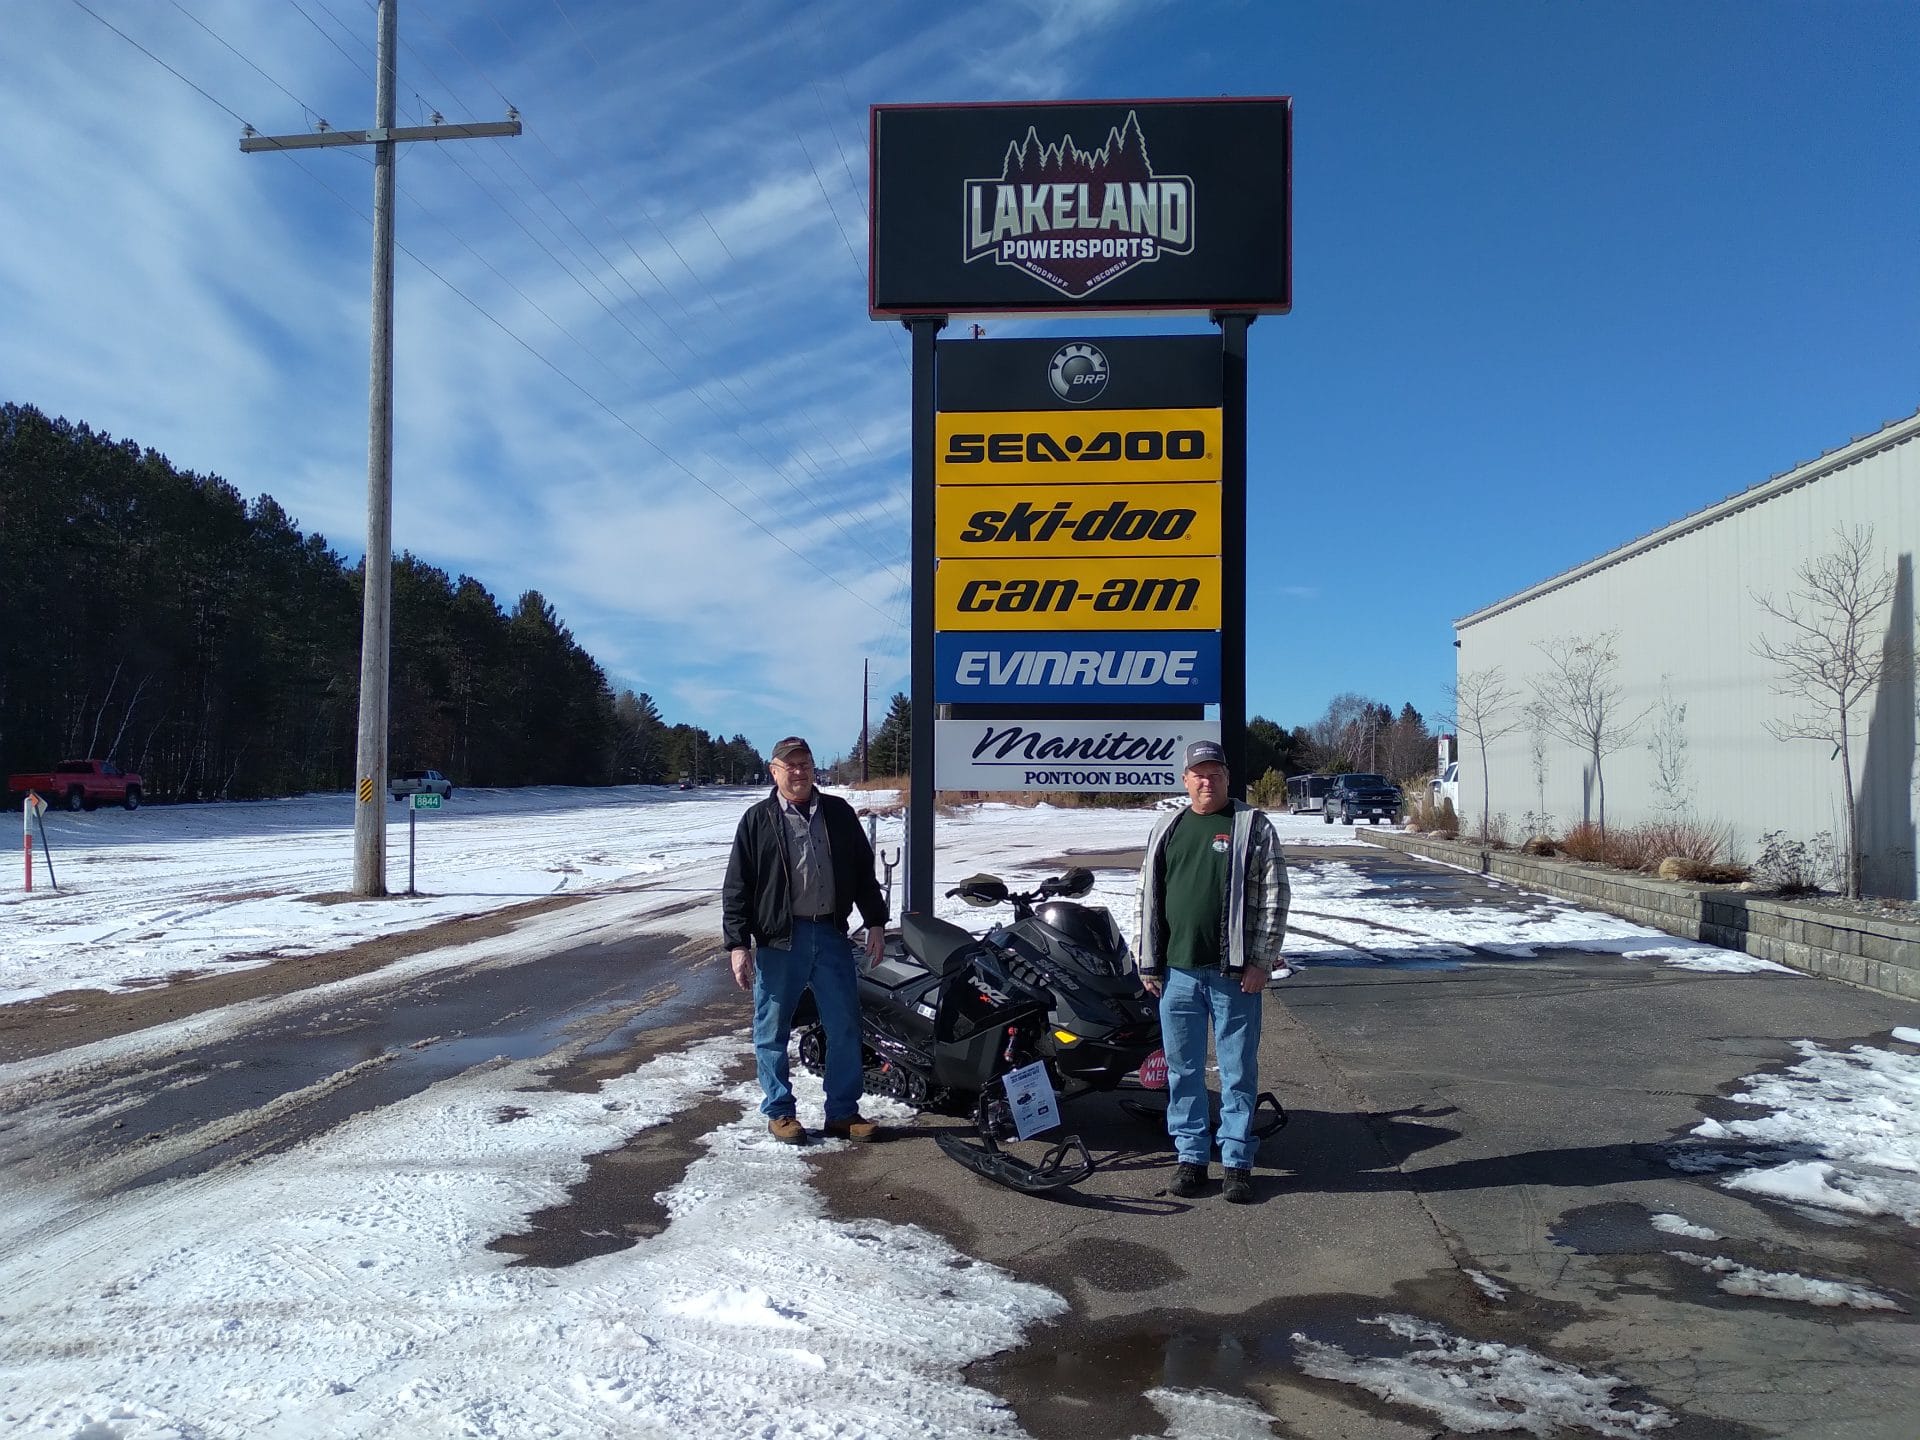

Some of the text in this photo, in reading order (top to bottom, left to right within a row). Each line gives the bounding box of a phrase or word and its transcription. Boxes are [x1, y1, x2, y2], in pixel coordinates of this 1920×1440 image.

[972, 182, 1188, 250] LAKELAND
[1003, 237, 1154, 260] POWERSPORTS
[1025, 261, 1069, 288] WOODRUFF
[1086, 260, 1128, 287] WISCONSIN
[1073, 374, 1106, 386] BRP
[960, 501, 1197, 542] ski-doo
[957, 578, 1201, 612] can-am
[955, 650, 1198, 685] EVINRUDE
[972, 727, 1175, 761] Manitou
[1024, 771, 1175, 785] PONTOON BOATS
[417, 797, 438, 806] 8844
[968, 976, 1010, 1004] MXZ
[1144, 1070, 1166, 1082] ME!
[1147, 1056, 1168, 1069] WIN
